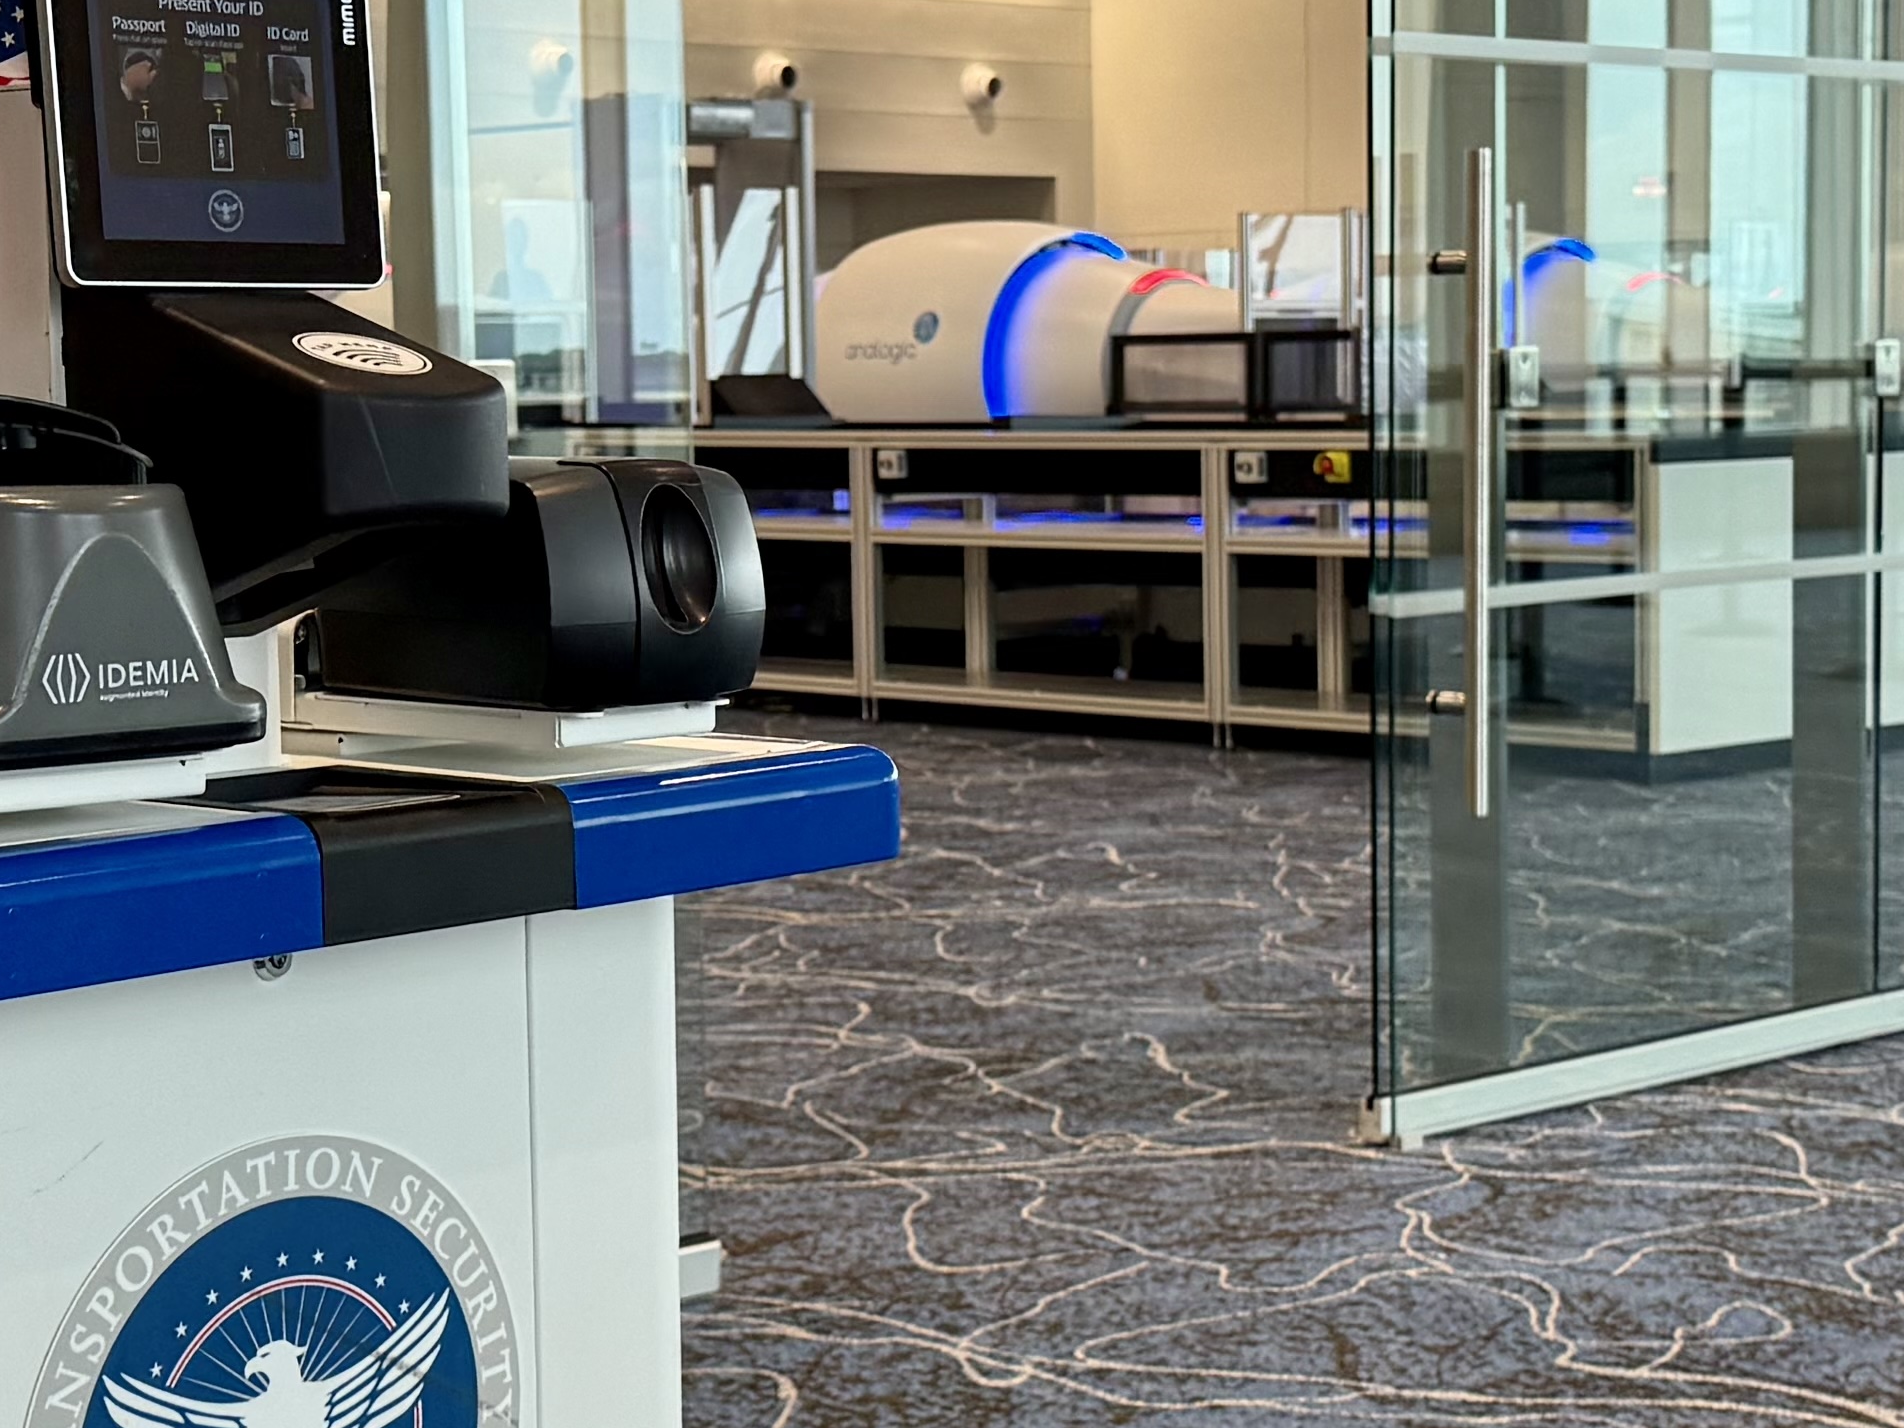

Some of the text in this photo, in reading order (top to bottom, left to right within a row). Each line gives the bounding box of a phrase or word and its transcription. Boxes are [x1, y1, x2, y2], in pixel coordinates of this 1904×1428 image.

[249, 1, 264, 17] ID
[112, 16, 166, 35] Passport
[186, 20, 241, 38] Digital ID
[266, 26, 309, 42] ID Card
[98, 658, 200, 689] IDEMIA
[392, 1173, 514, 1428] SECURITY
